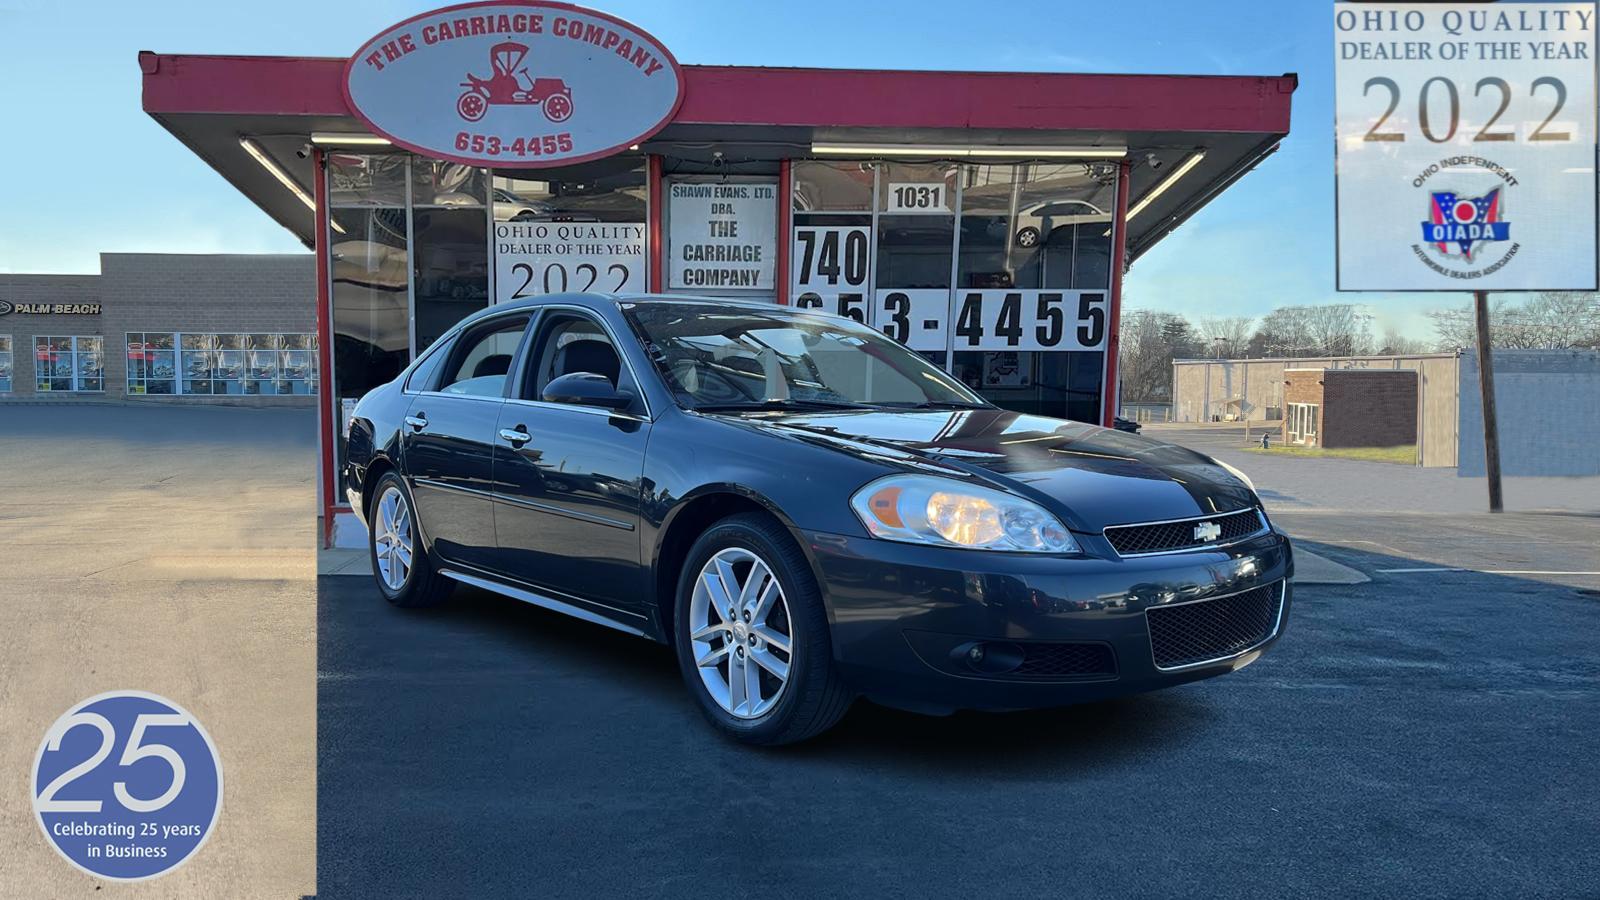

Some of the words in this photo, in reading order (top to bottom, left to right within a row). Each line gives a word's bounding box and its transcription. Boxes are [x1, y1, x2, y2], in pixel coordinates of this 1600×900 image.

[1336, 10, 1425, 31] OHIO
[1442, 9, 1593, 36] QUALITY
[366, 33, 416, 72] THE
[422, 14, 543, 45] CARRIAGE
[553, 16, 664, 77] COMPANY
[1340, 41, 1433, 60] DEALER
[1439, 41, 1469, 60] OF
[1475, 41, 1522, 60] THE
[1528, 41, 1589, 60] YEAR
[1363, 76, 1570, 143] 2022
[455, 131, 573, 157] 653-4455
[1412, 163, 1440, 188] OHIO
[1440, 155, 1519, 187] INDEPENDENT
[672, 186, 712, 199] SHAWN
[754, 187, 775, 199] LTD.
[894, 186, 940, 208] 1031
[711, 203, 736, 215] DBA.
[497, 226, 548, 239] OHIO
[558, 226, 644, 241] QUALITY
[708, 221, 738, 238] THE
[1432, 224, 1495, 240] OIADA
[500, 243, 552, 255] DEALER
[555, 243, 573, 255] OF
[576, 243, 603, 255] THE
[605, 244, 641, 255] YEAR
[683, 244, 762, 262] CARRIAGE
[797, 230, 868, 286] 740
[511, 263, 629, 299] 2022
[683, 268, 760, 286] COMPANY
[1449, 270, 1482, 280] DEALERS
[15, 304, 50, 314] PALM
[55, 304, 100, 314] BEACH
[796, 292, 1105, 347] 53-4455
